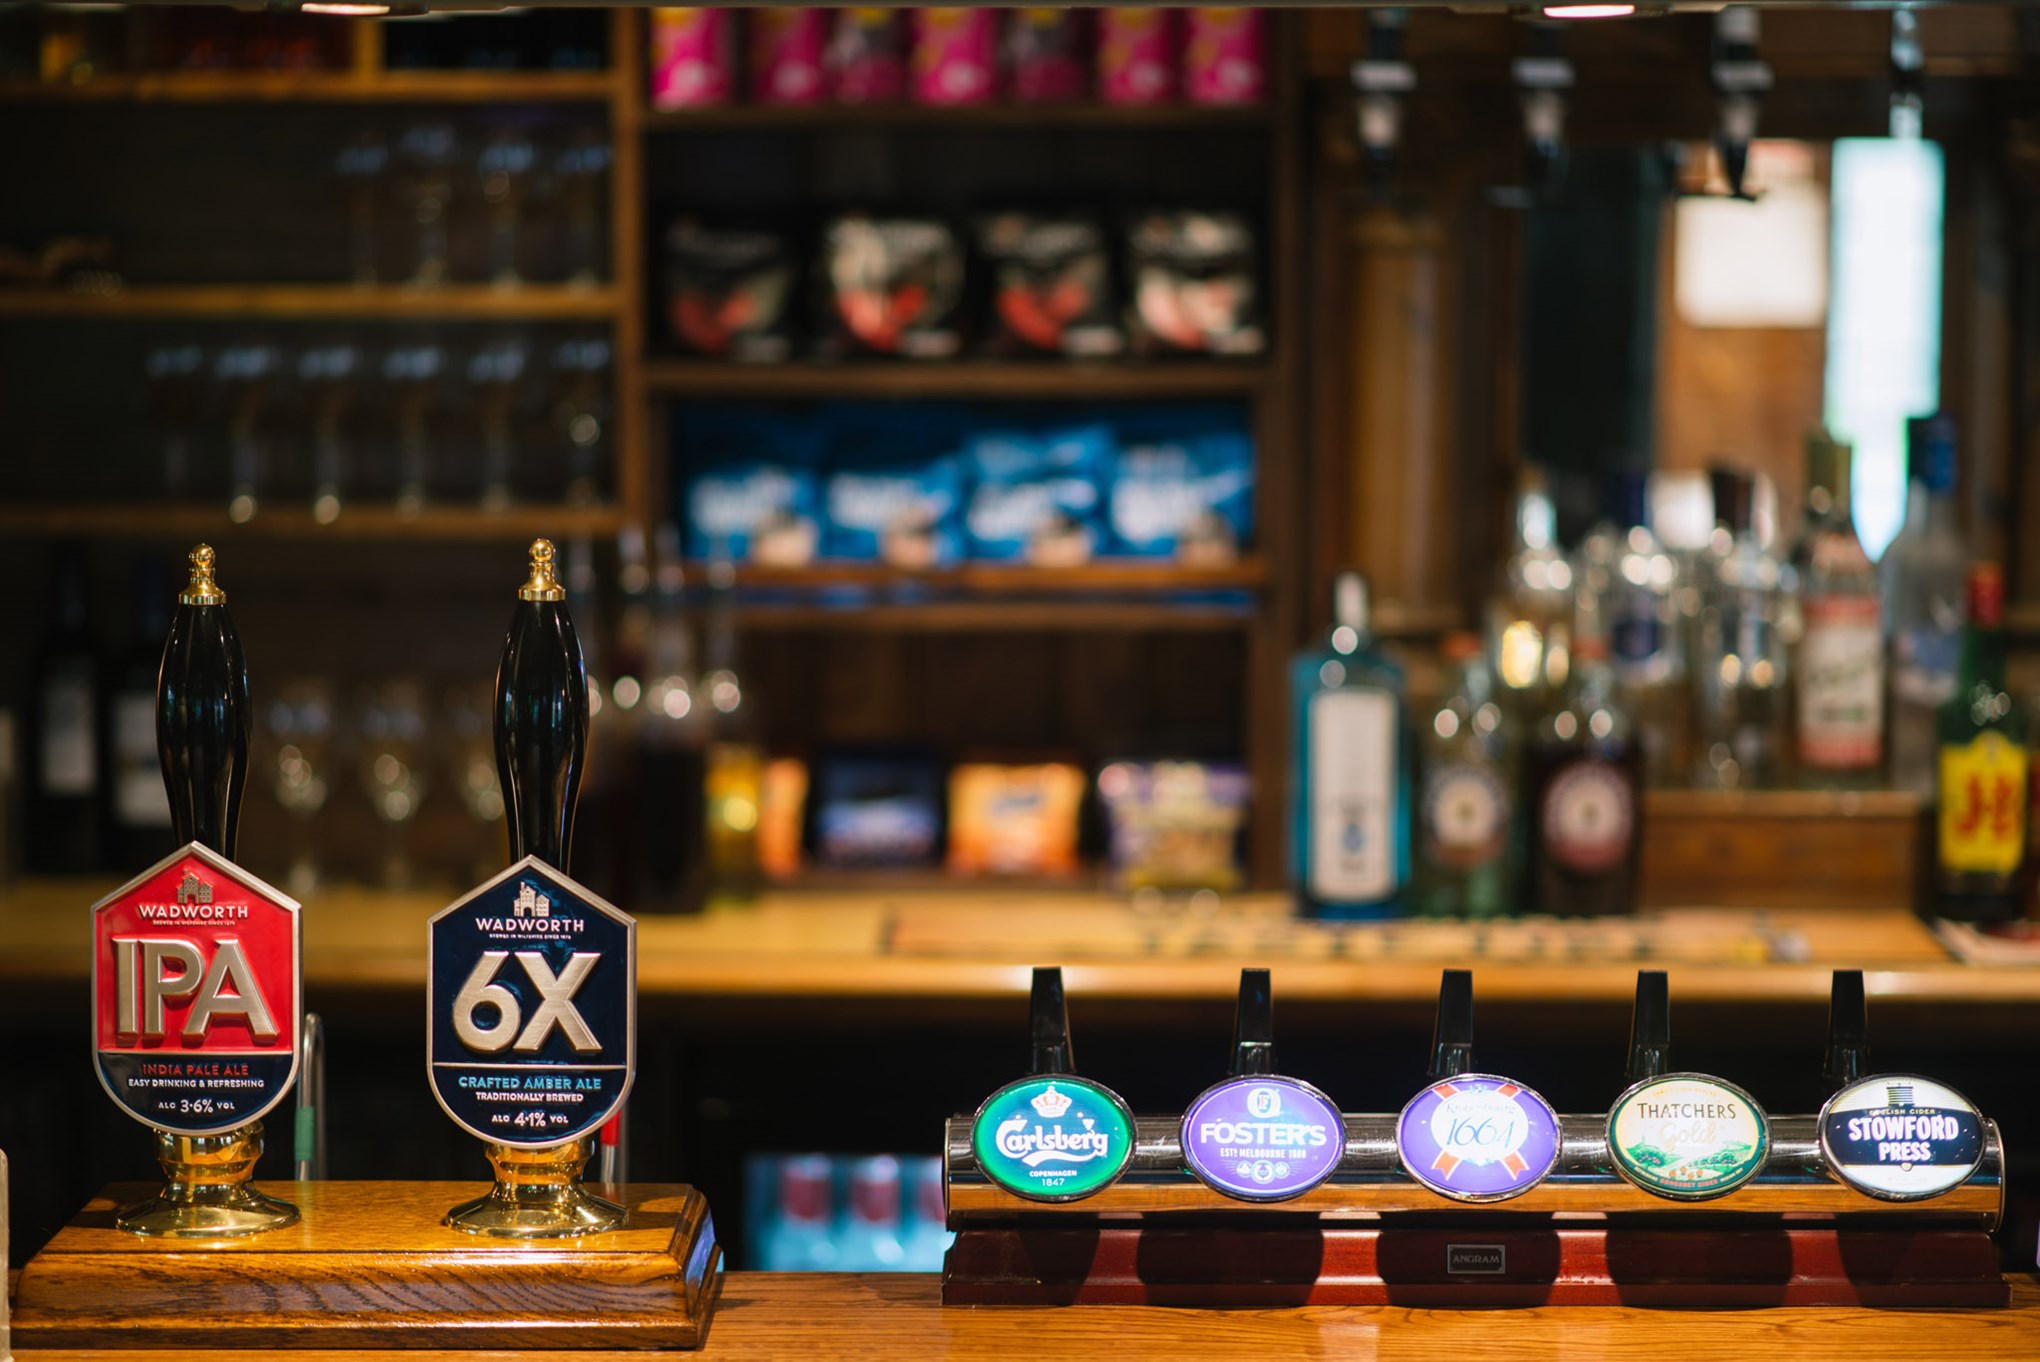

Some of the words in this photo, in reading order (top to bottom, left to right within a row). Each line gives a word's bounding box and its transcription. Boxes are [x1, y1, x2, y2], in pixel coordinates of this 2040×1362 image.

[139, 905, 248, 918] WADWORTH
[476, 918, 584, 932] WADWORTH
[112, 938, 280, 1041] IPA
[453, 951, 602, 1051] 6X
[143, 1063, 182, 1076] INDIA
[186, 1064, 220, 1076] PALE
[223, 1065, 249, 1076] ALE
[128, 1078, 150, 1087] EASY
[152, 1079, 197, 1088] DRINKING
[199, 1079, 206, 1088] &
[208, 1079, 265, 1088] REFRESHING
[458, 1076, 520, 1089] CRAFTED
[523, 1077, 572, 1089] AMBER
[575, 1078, 602, 1089] ALE
[475, 1091, 545, 1101] TRADITIONALLY
[546, 1093, 584, 1102] BREWED
[217, 1102, 235, 1110] VOL
[1637, 1103, 1736, 1119] THATCHERS
[491, 1114, 510, 1123] ALC
[550, 1115, 569, 1123] VOL
[1200, 1122, 1327, 1146] FOSTER'S
[1446, 1116, 1515, 1148] 1664
[1848, 1116, 1959, 1141] STOWFORD
[996, 1119, 1109, 1160] Carlsberg
[1660, 1121, 1717, 1152] Gold
[1239, 1148, 1285, 1158] MELBOURNE
[1878, 1141, 1932, 1162] PRESS
[1041, 1178, 1065, 1186] 1847
[1453, 1255, 1500, 1263] ANGRAM
